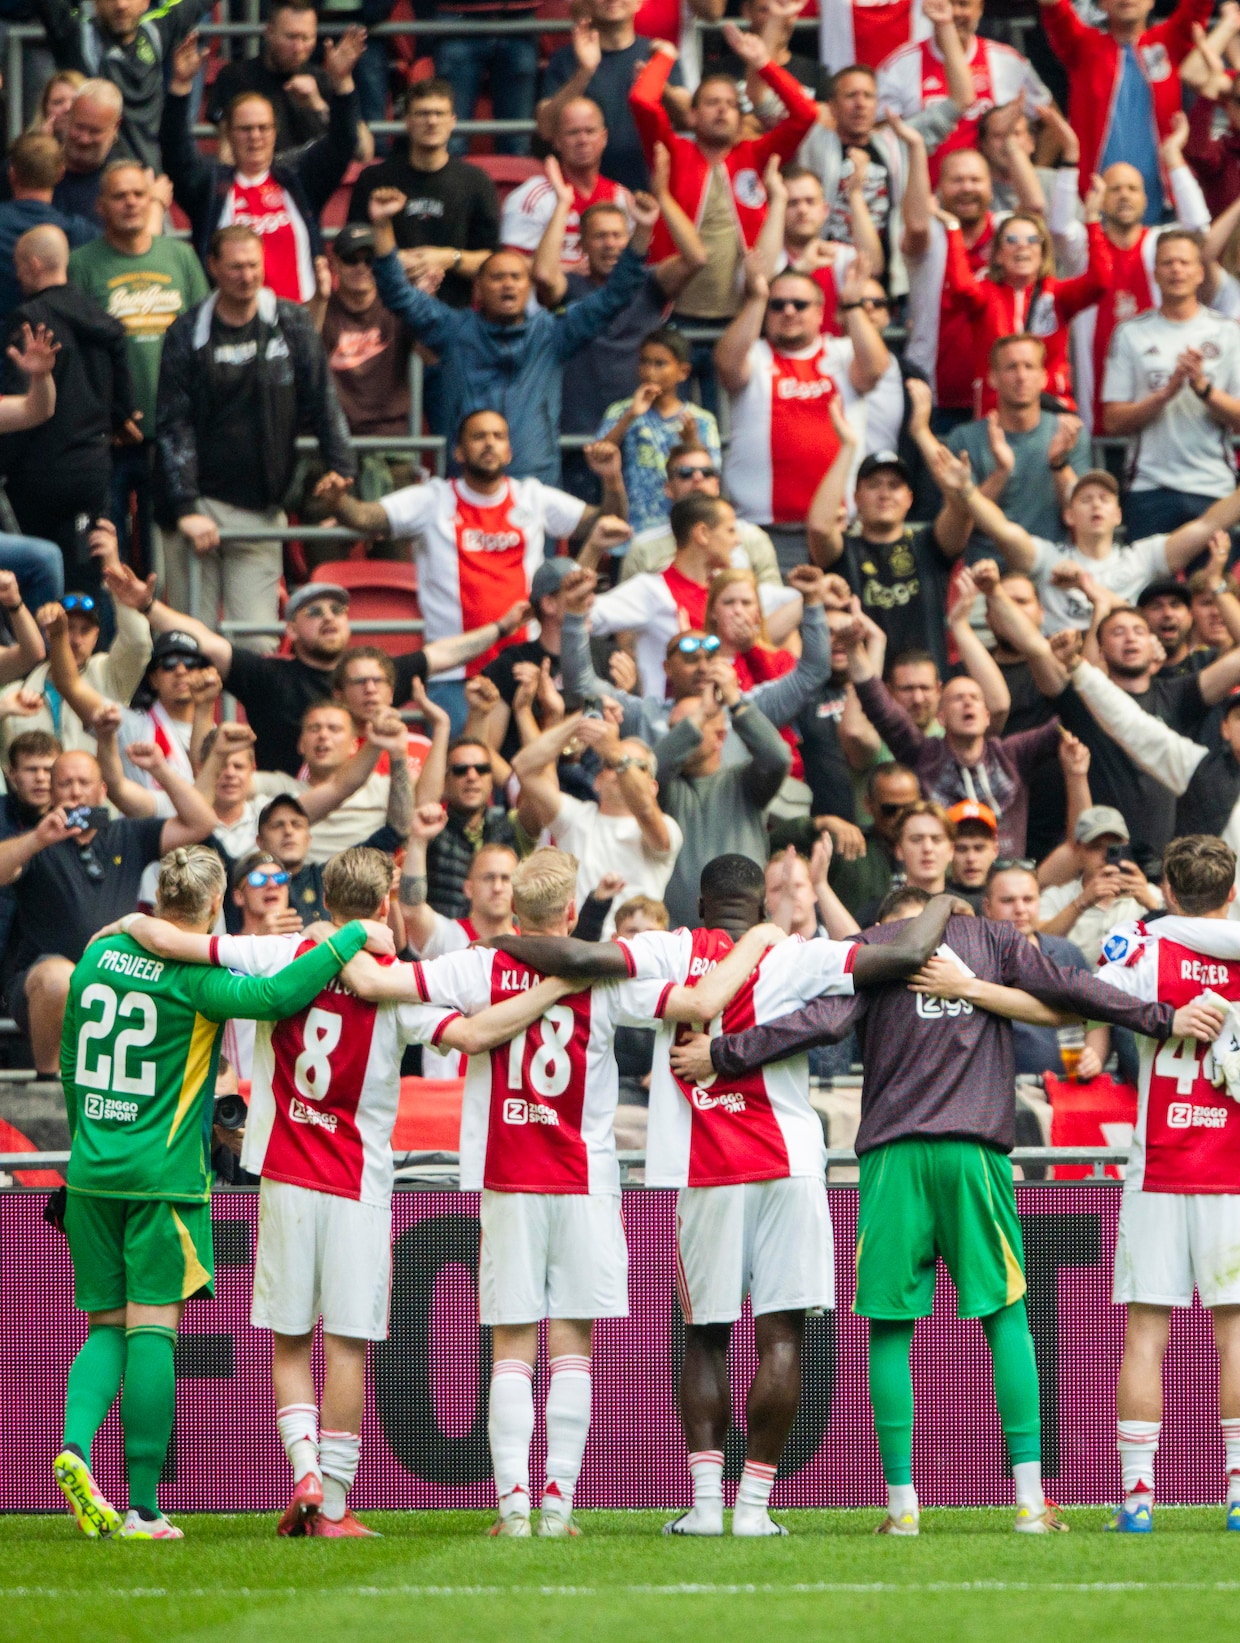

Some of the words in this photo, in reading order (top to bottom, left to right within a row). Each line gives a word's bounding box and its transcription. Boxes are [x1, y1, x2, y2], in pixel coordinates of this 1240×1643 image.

[97, 949, 165, 983] PASVEER
[74, 983, 158, 1096] 22
[293, 1006, 343, 1102] 8
[104, 1098, 139, 1114] ZIGGO
[1193, 1105, 1228, 1118] ZIGGO
[104, 1109, 138, 1122] SPORT
[1192, 1115, 1228, 1128] SPORT
